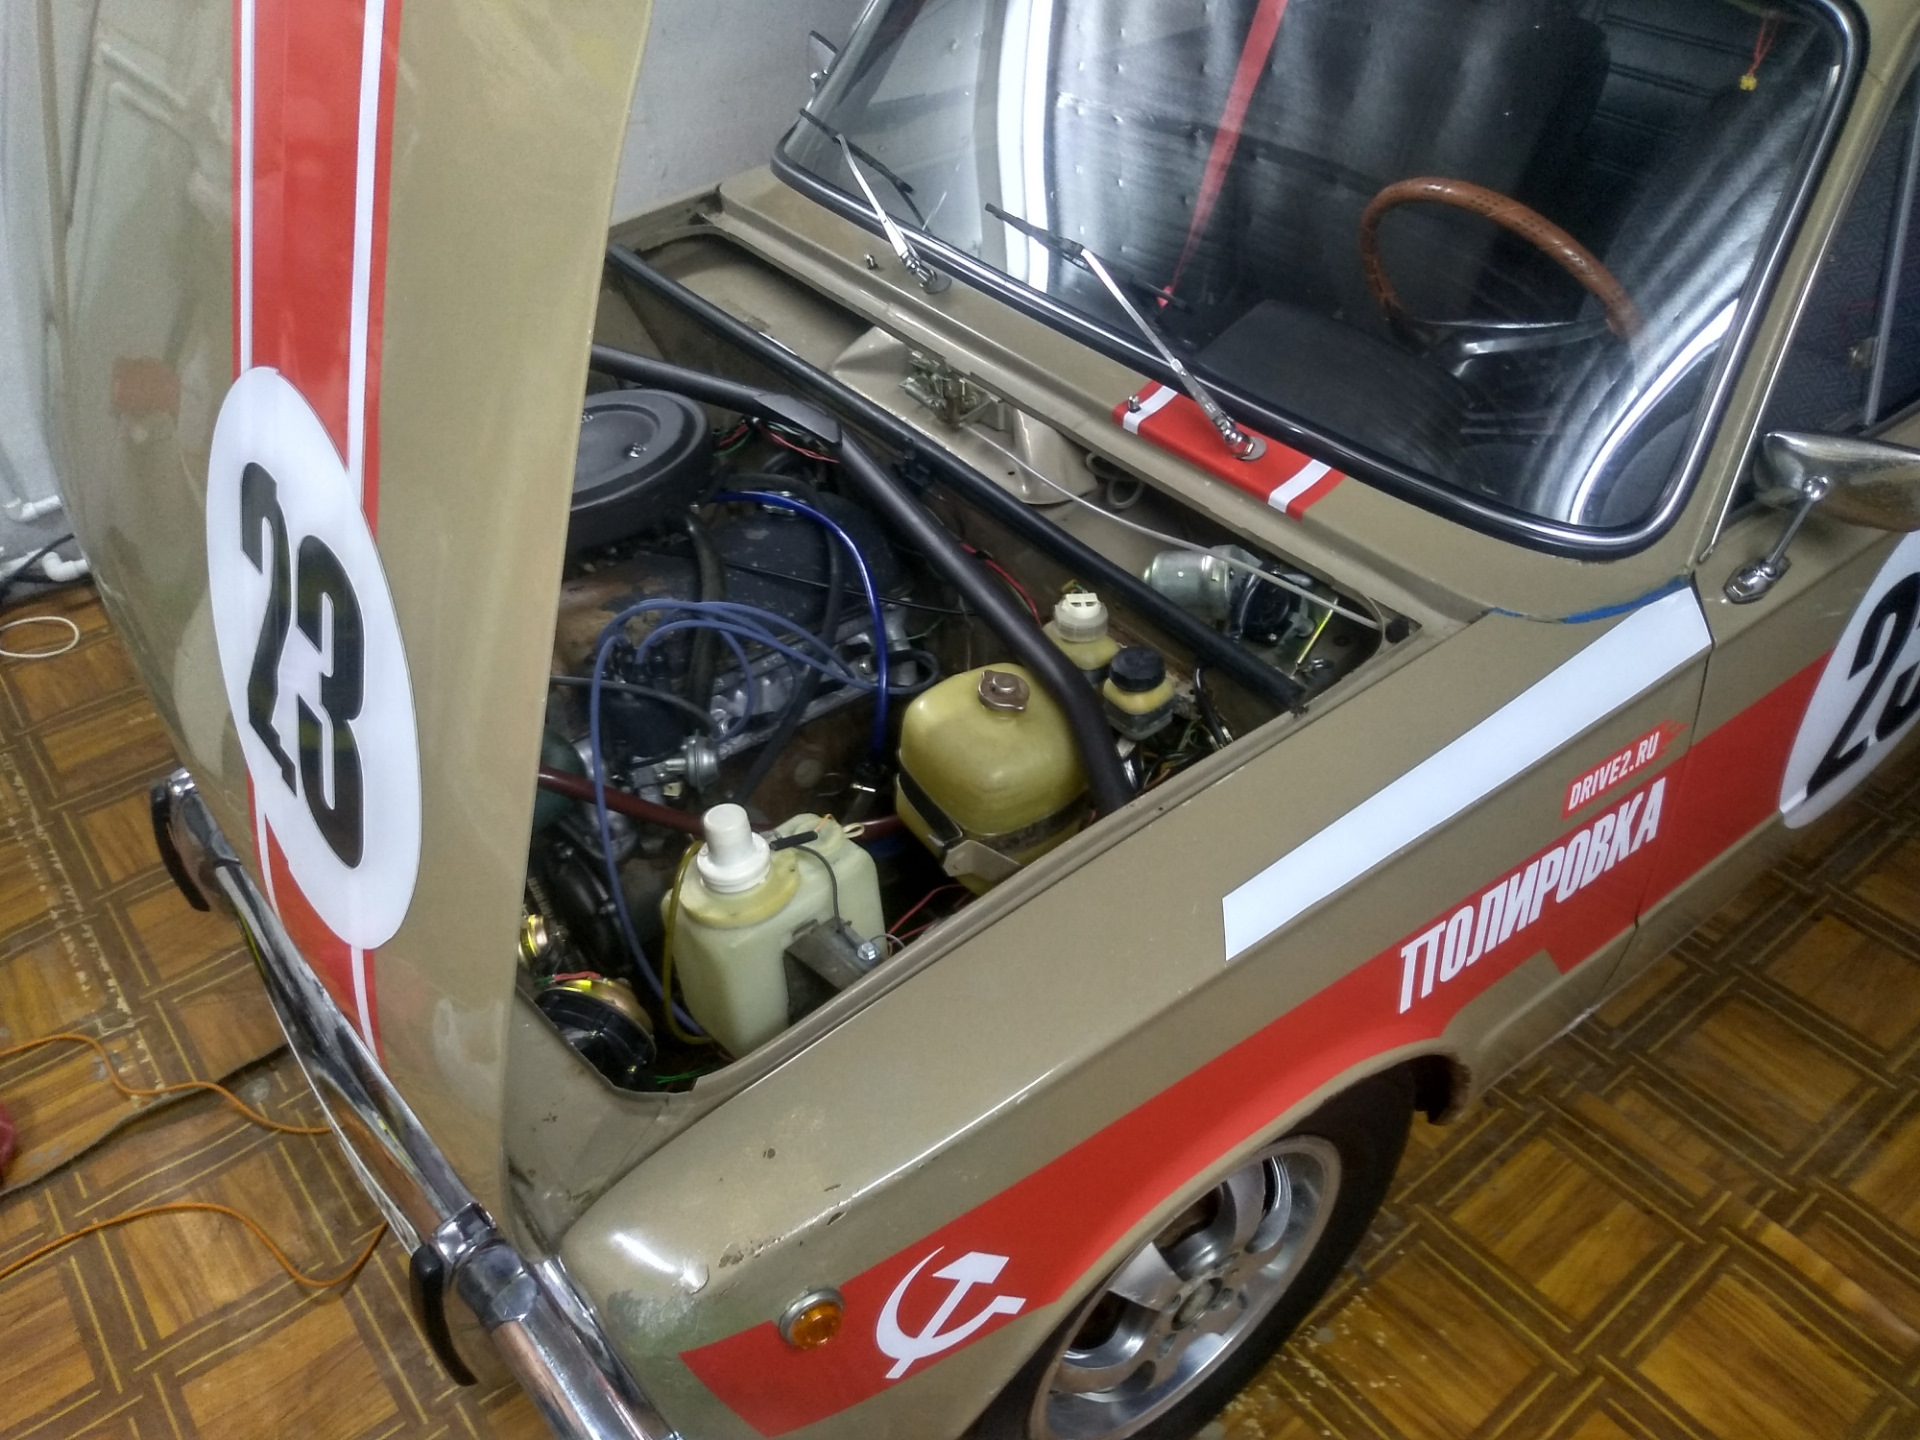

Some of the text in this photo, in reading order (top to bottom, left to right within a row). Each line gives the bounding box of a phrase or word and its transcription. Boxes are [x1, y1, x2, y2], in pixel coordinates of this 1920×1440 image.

[241, 462, 364, 869] 23
[1568, 731, 1660, 811] DRIVE2.RU
[1399, 777, 1666, 1015] ПОЛИРОВКА
